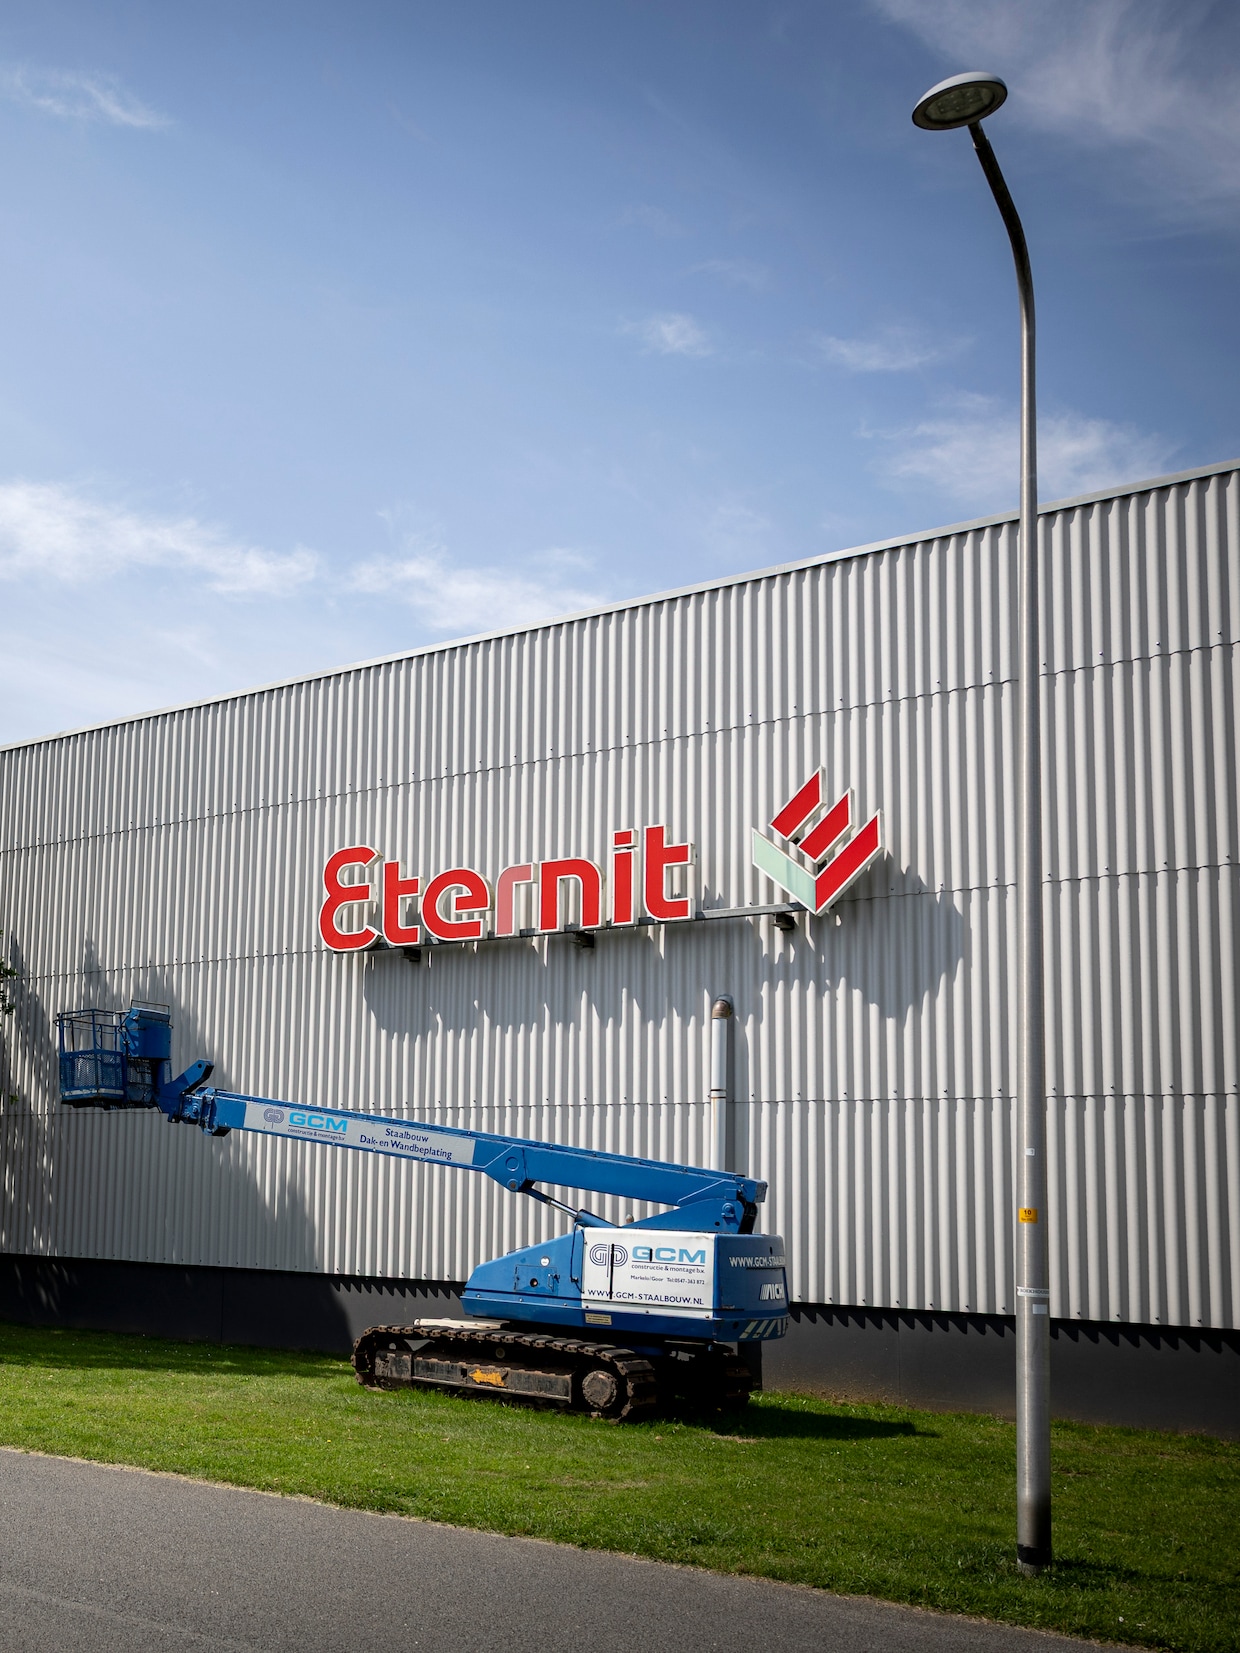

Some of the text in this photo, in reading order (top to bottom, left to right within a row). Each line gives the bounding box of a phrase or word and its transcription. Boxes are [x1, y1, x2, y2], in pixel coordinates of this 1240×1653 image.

[318, 825, 695, 952] Eternit
[289, 1111, 348, 1133] GCM
[288, 1127, 313, 1137] constructie
[318, 1132, 338, 1141] montage
[385, 1127, 429, 1143] Staalbouw
[359, 1134, 378, 1145] Dak-
[390, 1140, 453, 1160] Wandbeplating
[632, 1245, 706, 1264] GCM
[587, 1289, 705, 1305] WWW.GCM-STAALBOUW.NL
